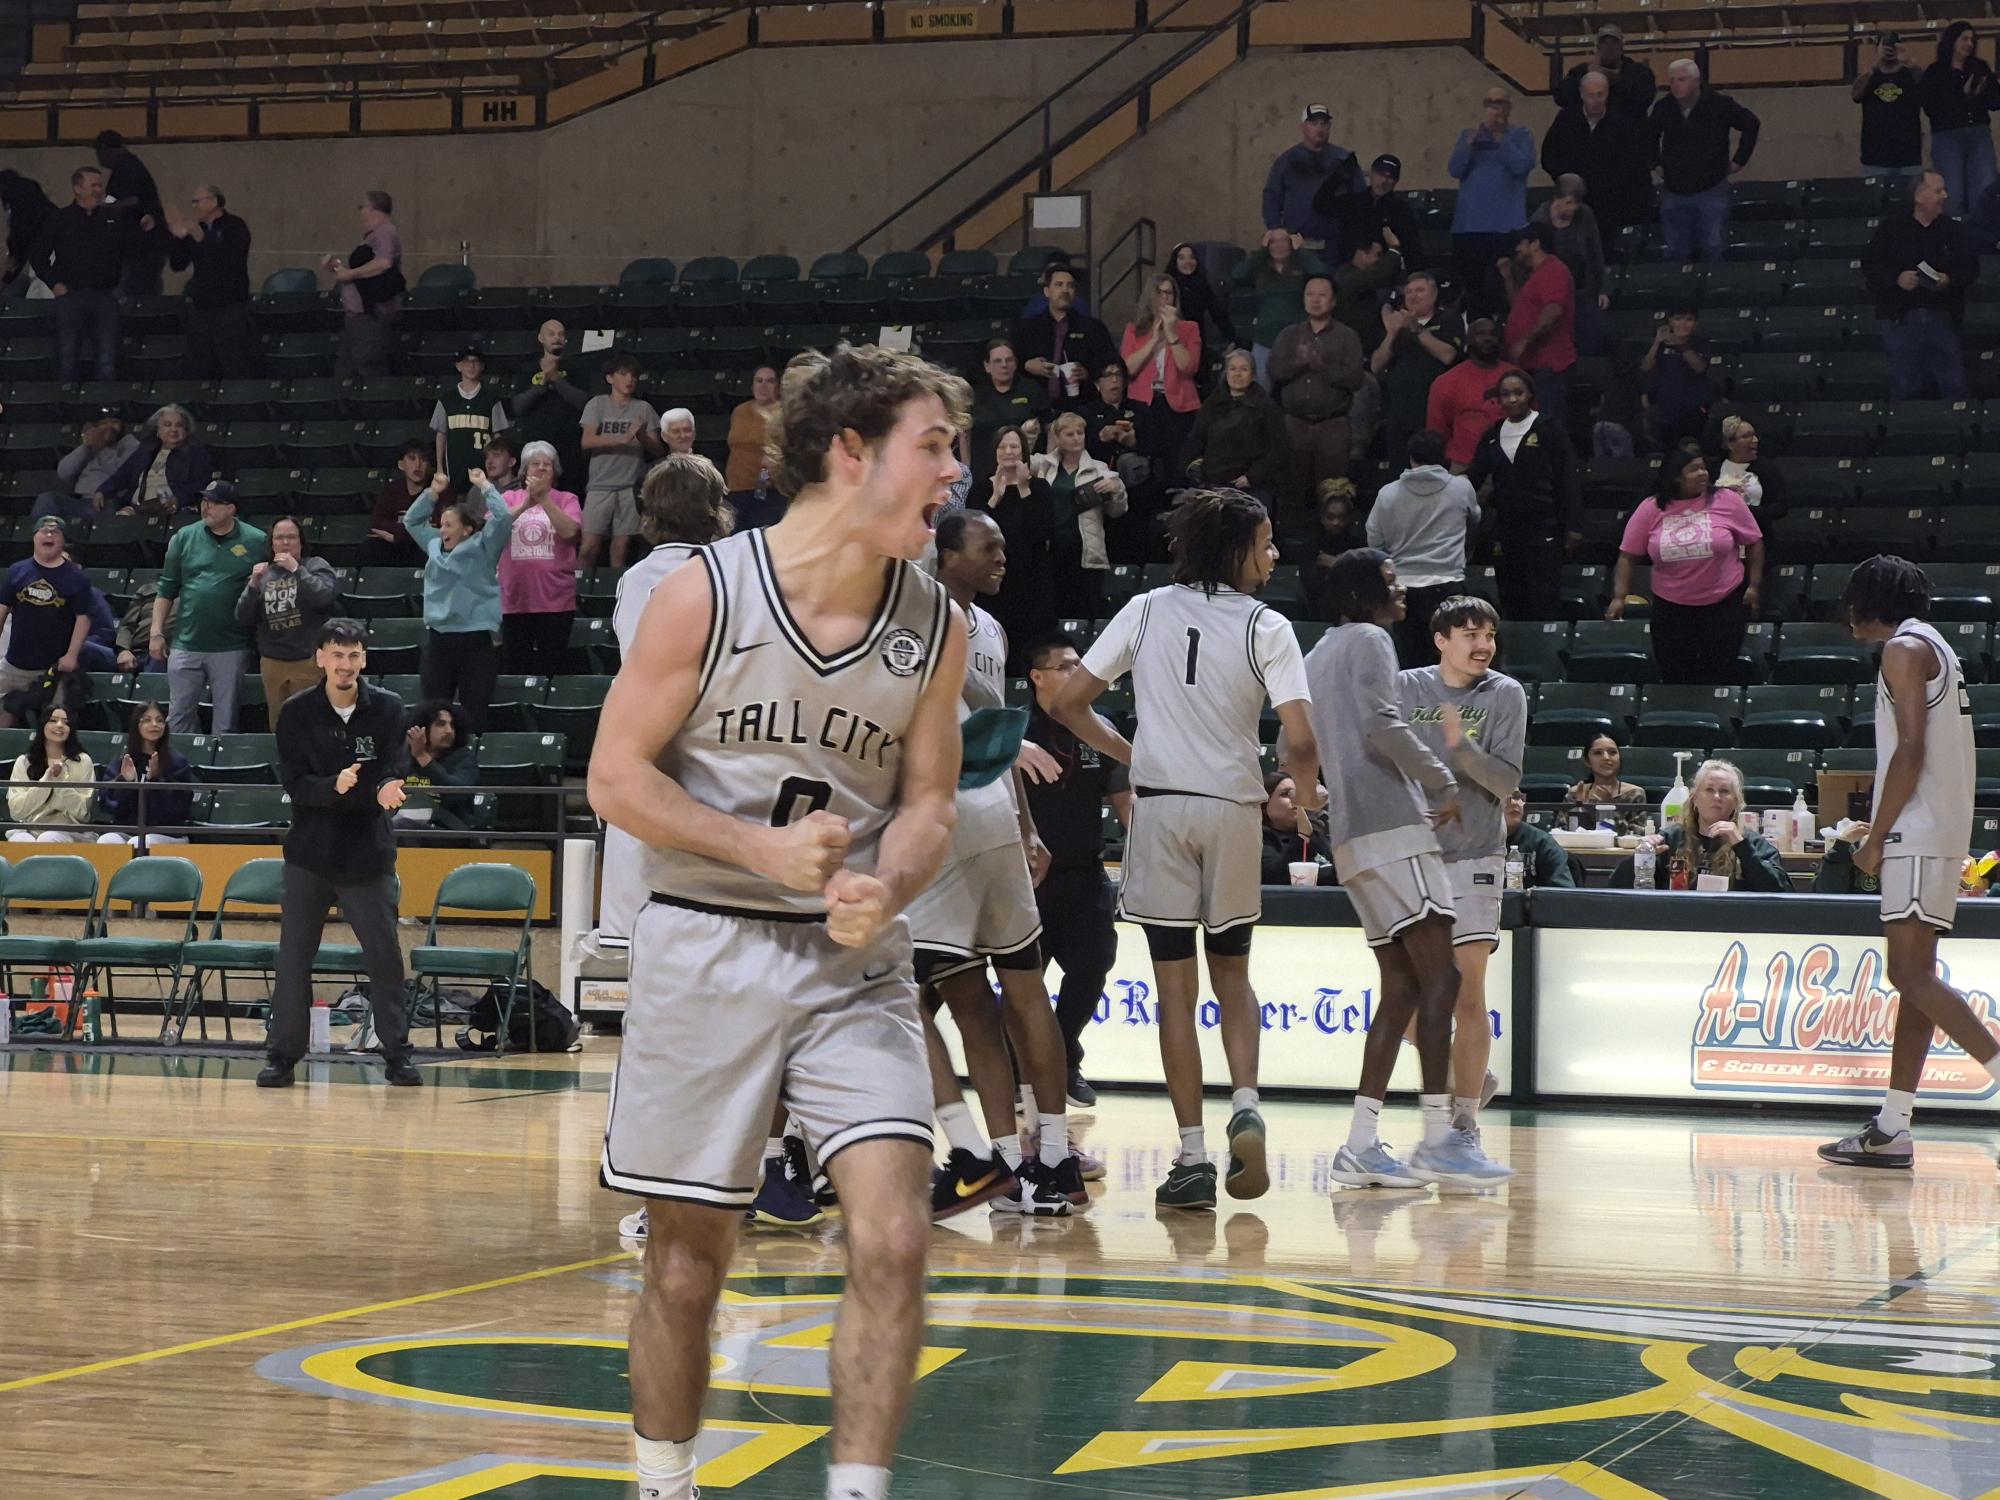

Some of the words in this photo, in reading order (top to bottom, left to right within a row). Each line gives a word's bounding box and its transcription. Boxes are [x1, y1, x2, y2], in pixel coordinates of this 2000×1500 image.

[910, 15, 924, 29] NO
[928, 13, 974, 28] SMOKING
[483, 101, 517, 122] HH
[264, 586, 298, 602] MON
[264, 598, 296, 614] KEY
[1185, 626, 1202, 686] 1
[715, 700, 808, 744] TALL
[819, 706, 902, 769] CITY
[1695, 941, 1793, 1045] A-1
[1722, 1060, 1805, 1076] SCREEN
[1808, 1063, 1892, 1080] PRINTI
[1924, 1067, 1967, 1082] INC.
